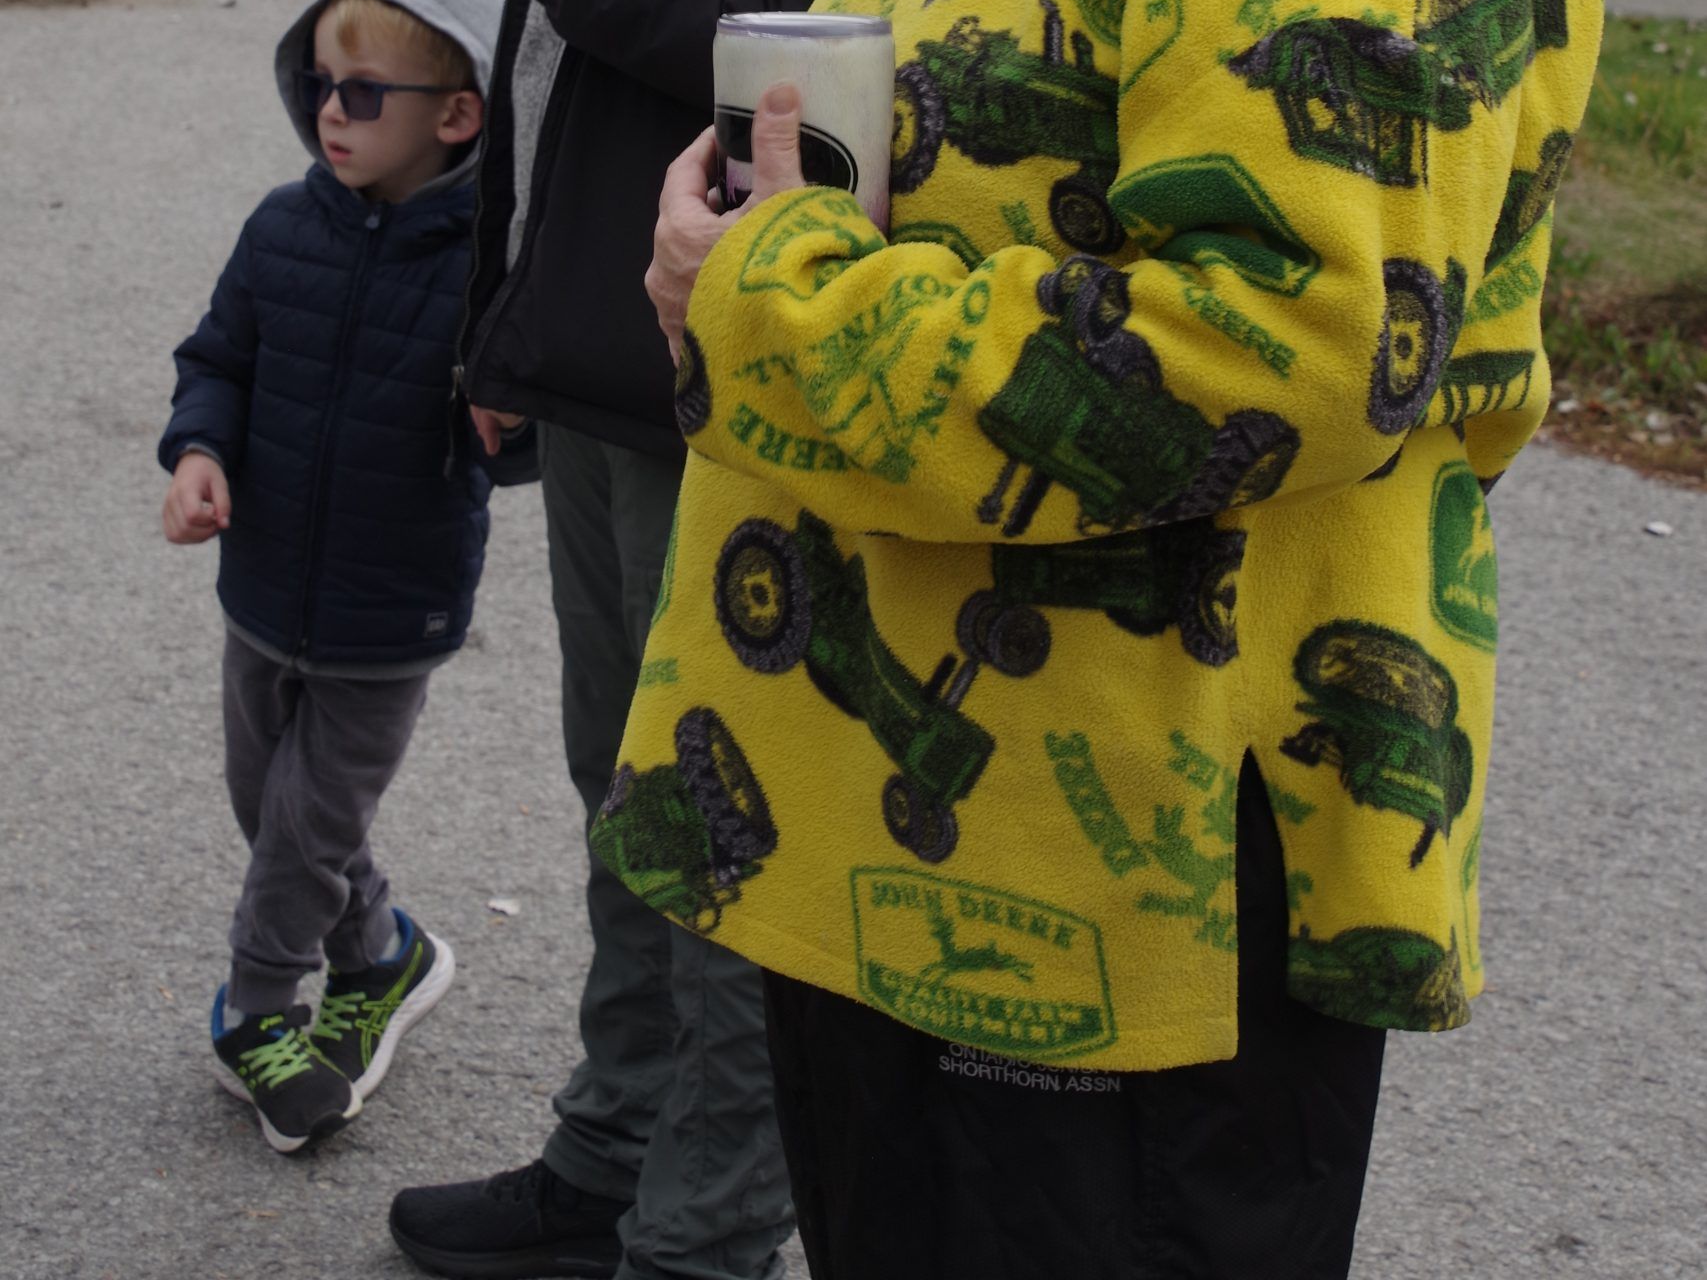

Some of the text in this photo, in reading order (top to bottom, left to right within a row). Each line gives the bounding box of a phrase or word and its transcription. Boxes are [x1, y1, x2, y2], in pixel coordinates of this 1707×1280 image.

[957, 893, 1076, 949] DEERE
[938, 1055, 1121, 1093] SHORTHORN ASSN
